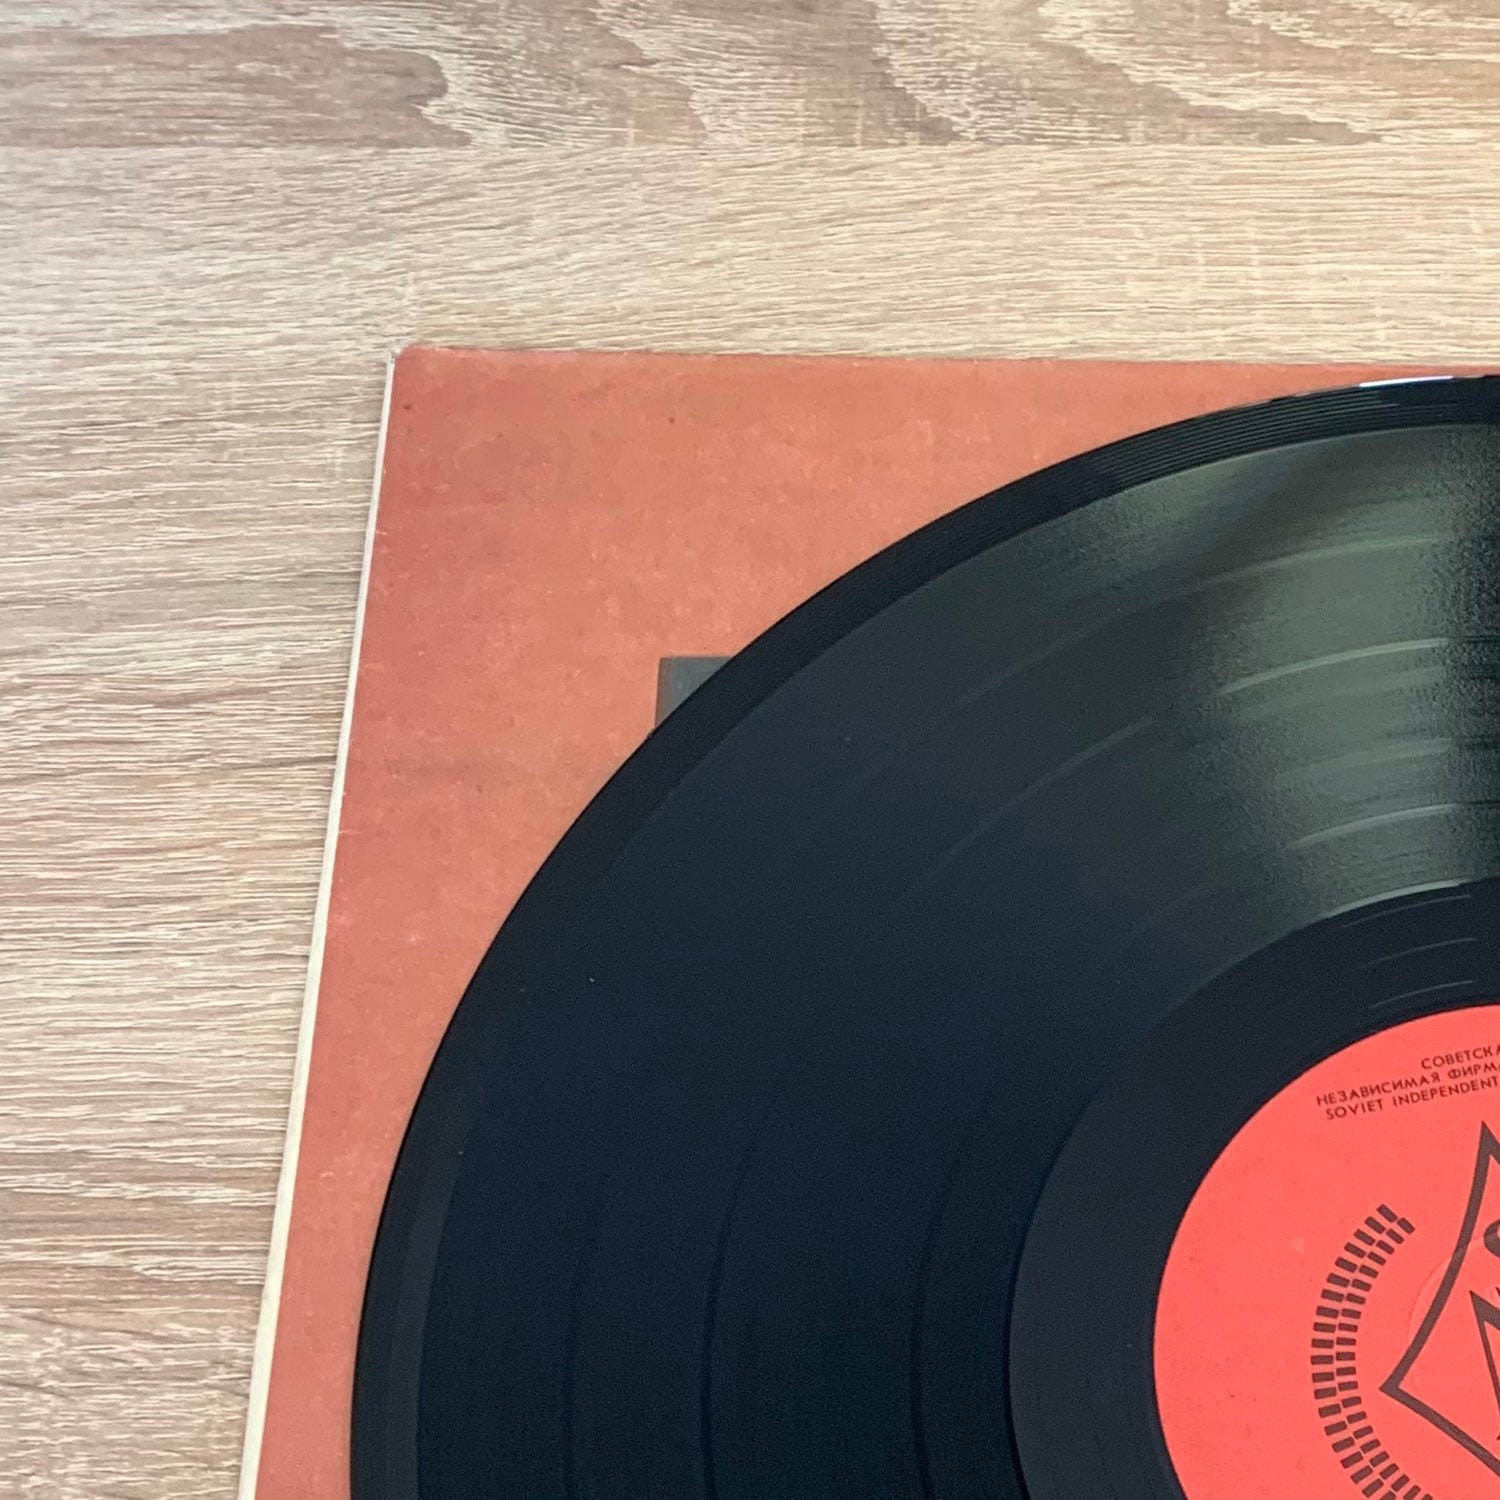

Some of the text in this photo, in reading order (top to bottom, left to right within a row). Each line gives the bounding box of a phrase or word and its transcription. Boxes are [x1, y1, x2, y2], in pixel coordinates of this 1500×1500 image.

[1316, 1071, 1441, 1106] НЕЗАВИСИМАЯ
[1325, 1098, 1383, 1120] SOVIET
[1392, 1076, 1500, 1107] INDEPENDENT
